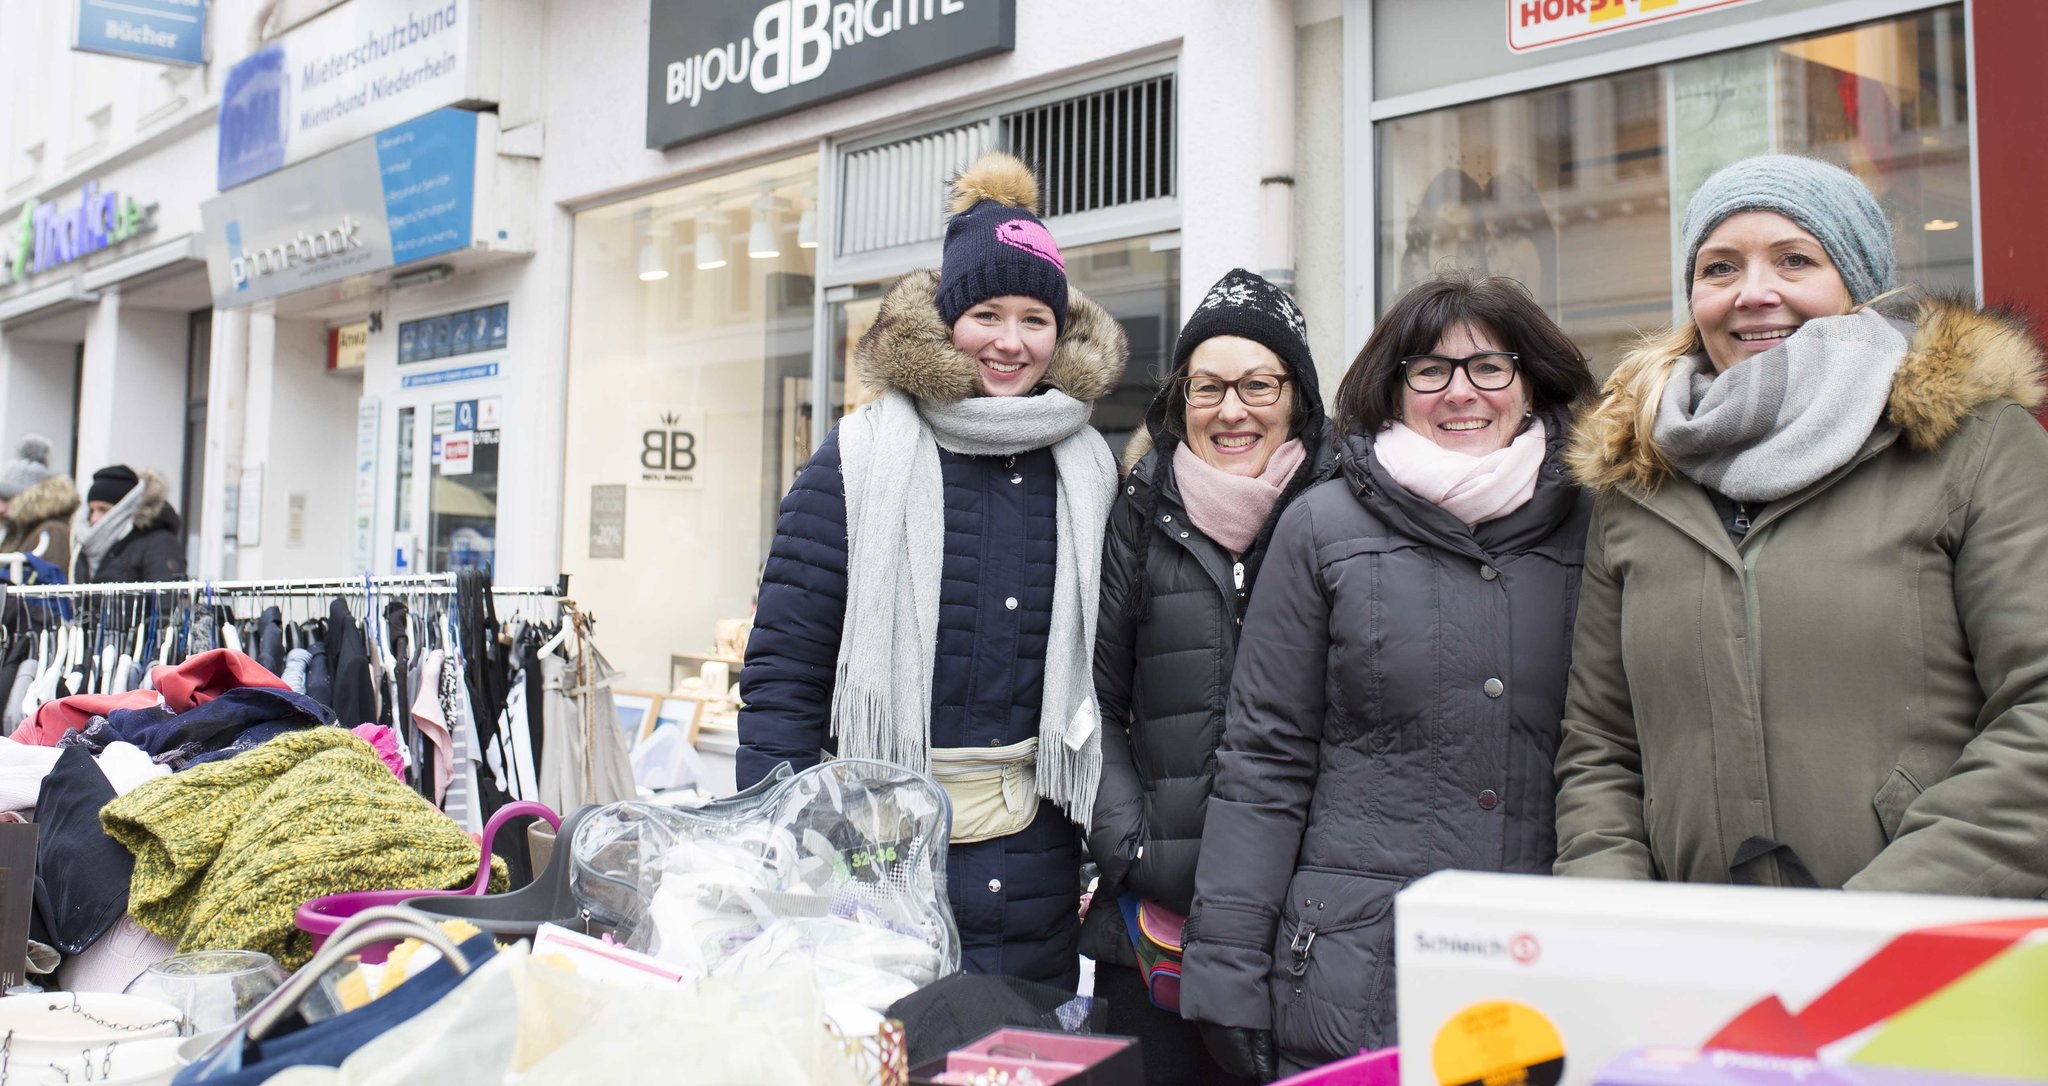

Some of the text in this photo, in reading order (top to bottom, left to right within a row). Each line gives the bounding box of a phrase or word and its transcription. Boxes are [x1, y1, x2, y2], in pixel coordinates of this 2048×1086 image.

[105, 19, 178, 48] Bücher
[302, 1, 457, 91] Mieterschutzbund
[301, 51, 456, 130] Mieterbund Niederrhein
[666, 37, 750, 107] BIJOU
[230, 215, 363, 291] phonebook
[851, 847, 897, 868] 32-36
